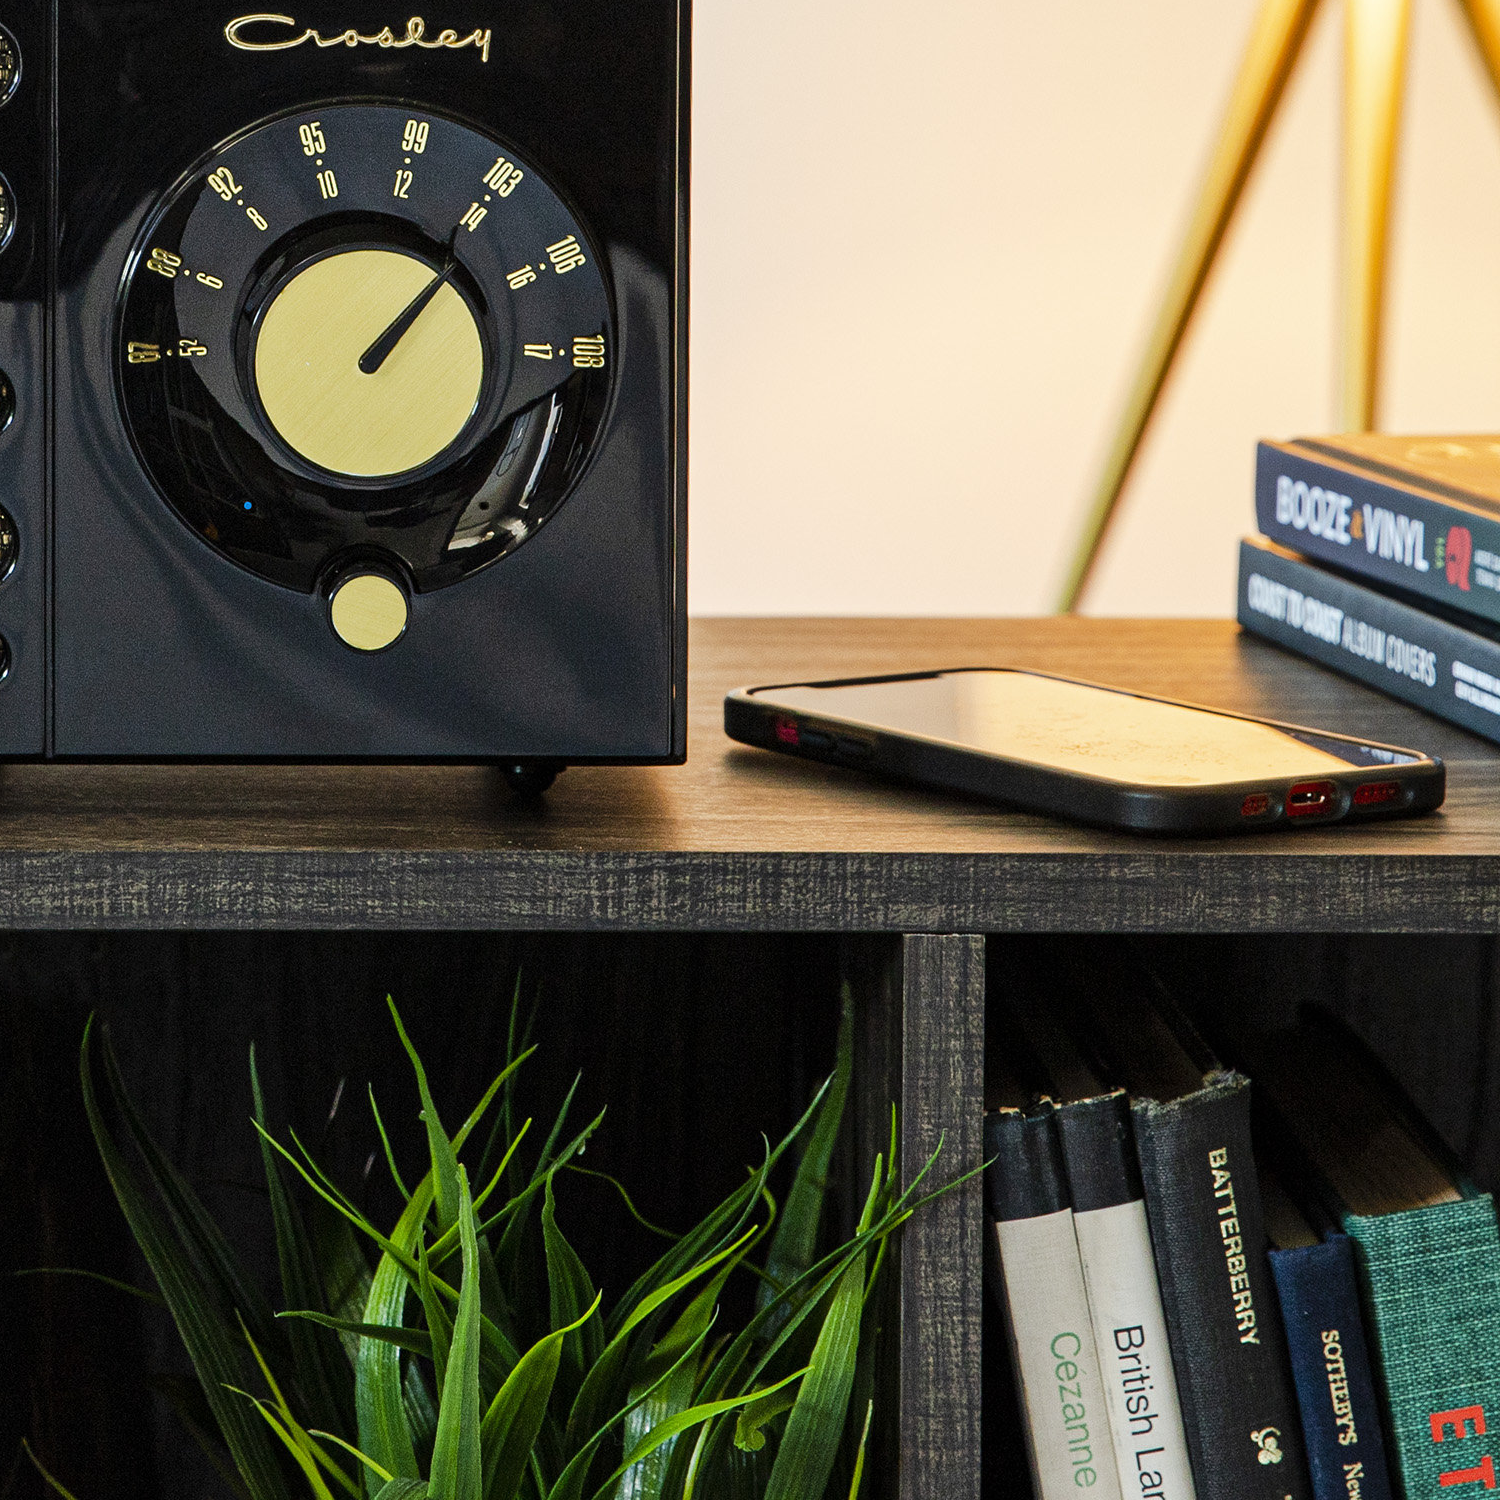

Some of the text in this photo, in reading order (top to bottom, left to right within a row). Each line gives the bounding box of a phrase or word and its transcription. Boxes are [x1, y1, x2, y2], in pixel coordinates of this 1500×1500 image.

[224, 13, 492, 63] Crosley
[299, 121, 326, 156] 95
[401, 119, 430, 155] 99
[206, 166, 244, 203] 92
[315, 171, 338, 200] 10
[393, 169, 413, 199] 12
[482, 156, 525, 199] 103
[246, 206, 268, 232] 8
[458, 202, 488, 234] 14
[146, 246, 182, 280] 88
[545, 233, 587, 276] 106
[197, 271, 224, 290] 6
[506, 263, 538, 291] 16
[128, 341, 161, 365] 87
[523, 341, 553, 362] 17
[573, 335, 605, 368] 108
[1275, 474, 1353, 546] BOOZE
[1362, 503, 1430, 573] VINYL
[1386, 634, 1437, 688] COVERS
[1208, 1146, 1260, 1346] BATTERBERRY
[1113, 1324, 1159, 1437] British
[1320, 1329, 1359, 1447] SOTHEBY'S
[1049, 1331, 1098, 1489] Cézanne
